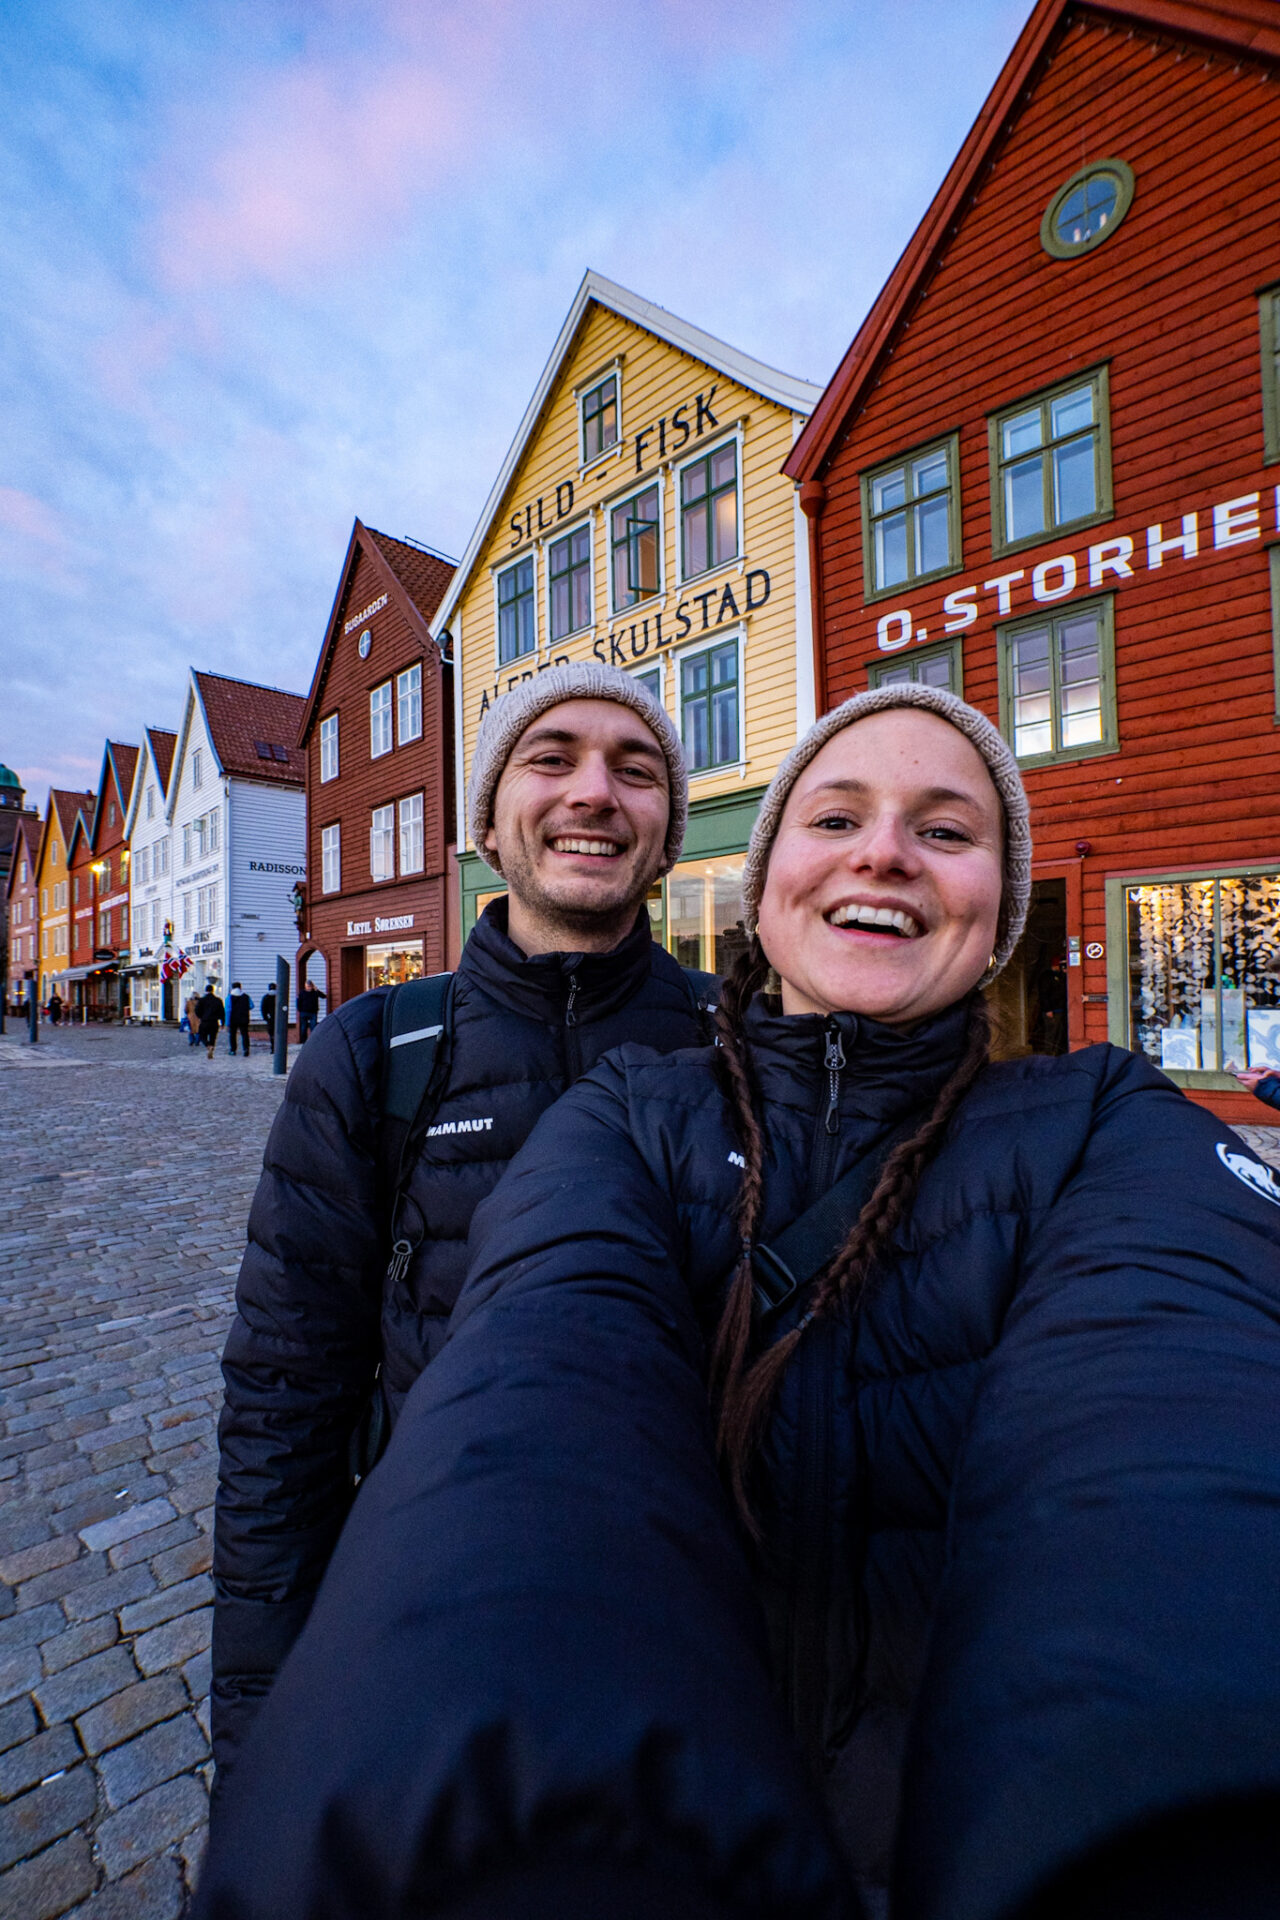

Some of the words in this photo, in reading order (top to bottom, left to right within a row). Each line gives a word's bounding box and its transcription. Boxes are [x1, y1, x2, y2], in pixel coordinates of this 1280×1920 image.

[510, 479, 574, 548] SILD
[634, 384, 719, 474] FISK
[593, 568, 771, 665] SKULSTAD
[877, 609, 928, 652] O.
[943, 485, 1280, 633] STORHE
[249, 861, 306, 875] RADISSON
